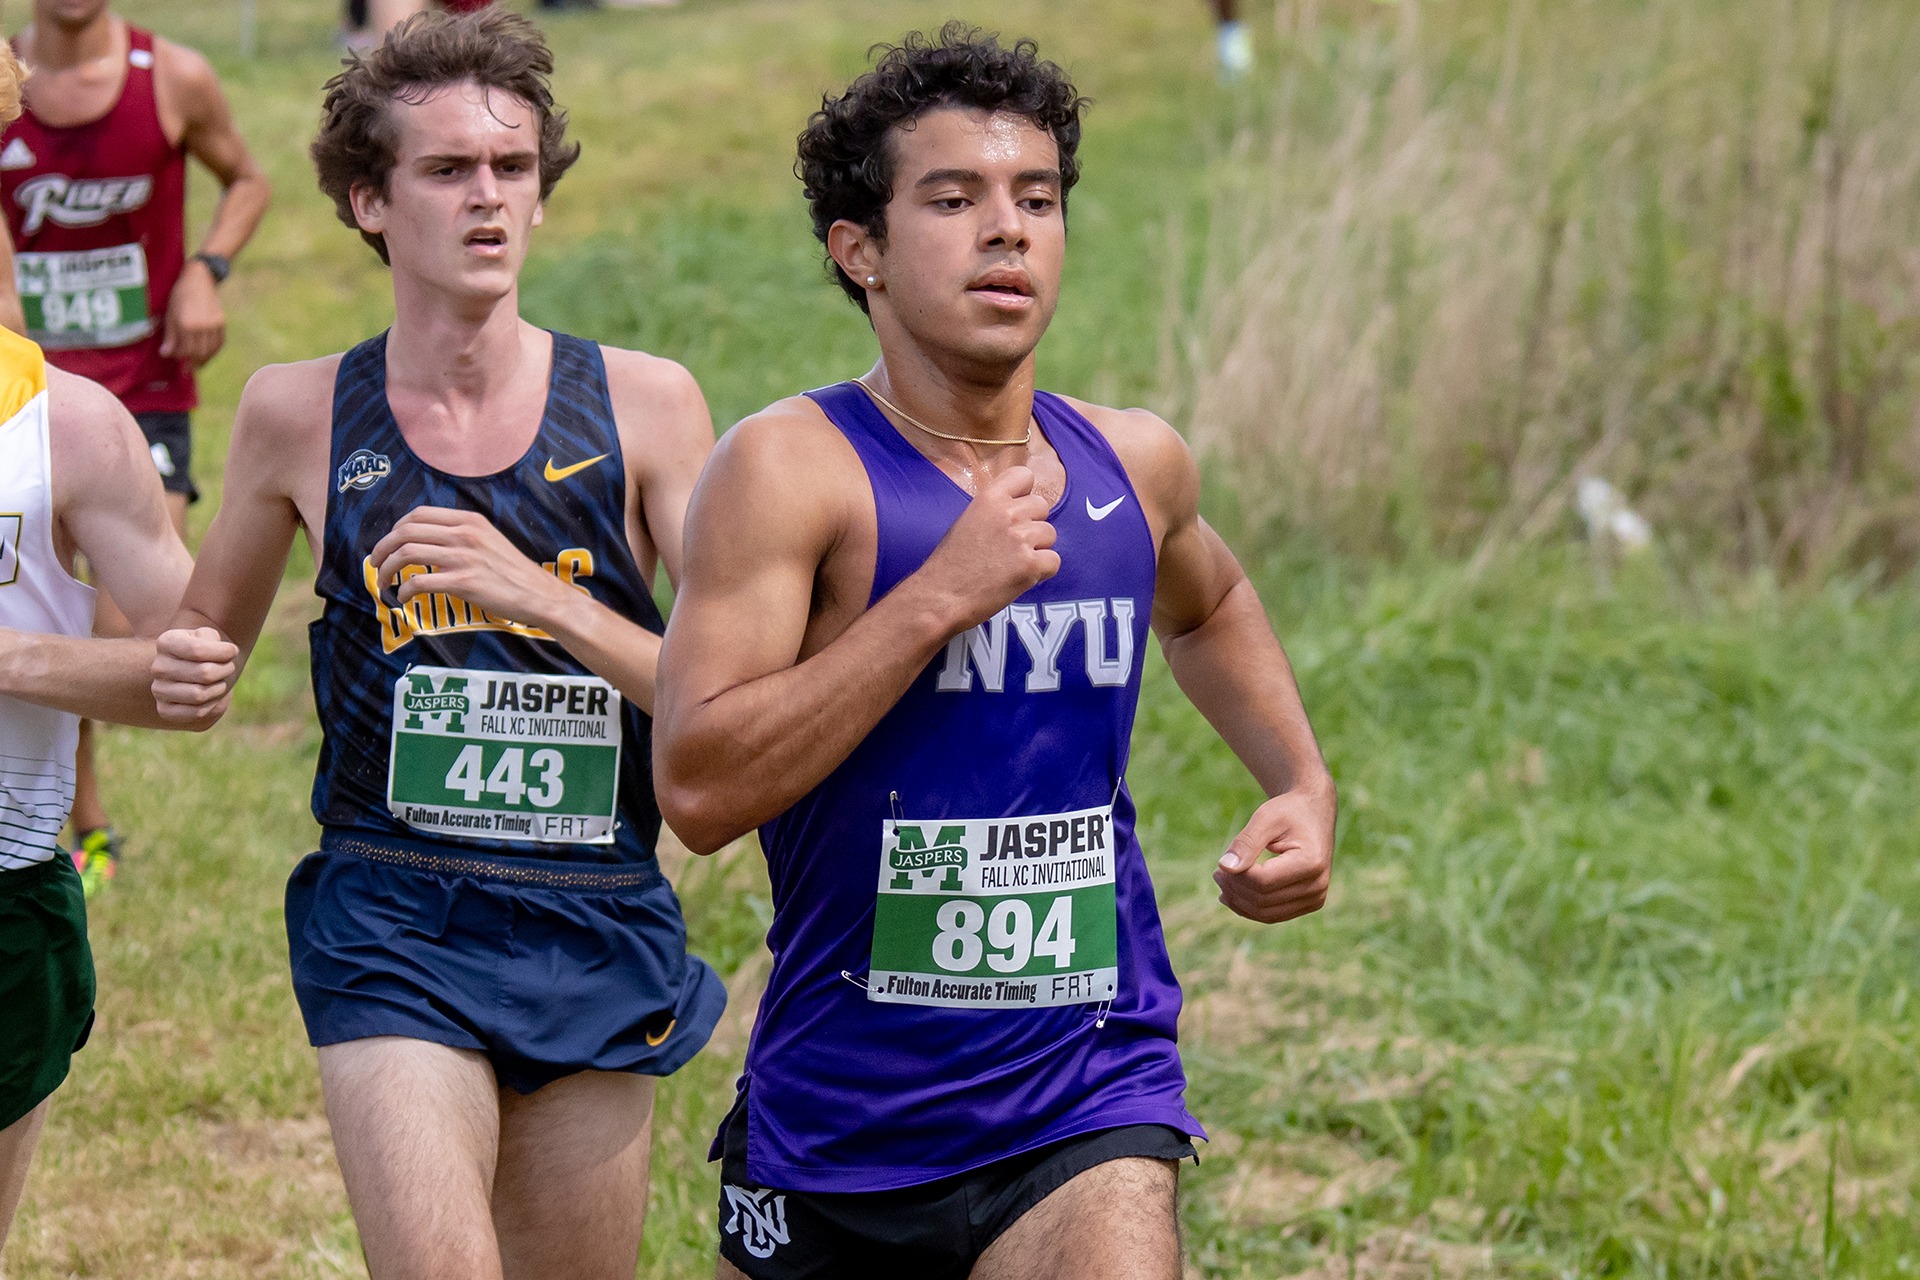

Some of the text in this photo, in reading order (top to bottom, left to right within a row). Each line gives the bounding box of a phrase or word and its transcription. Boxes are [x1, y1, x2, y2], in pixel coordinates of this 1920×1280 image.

[42, 288, 120, 333] 949
[339, 456, 387, 487] MAAC
[935, 597, 1136, 693] NYU
[407, 695, 465, 710] JASPERS
[480, 680, 609, 716] JASPER
[481, 715, 607, 739] FALL XC INVITATIONAL
[445, 744, 565, 808] 443
[405, 806, 531, 834] Fulton Accurate Timing
[979, 814, 1106, 861] JASPER
[894, 849, 964, 868] JASPERS
[981, 855, 1106, 888] FALL XC INVITATIONAL
[931, 895, 1076, 973] 894
[887, 975, 1037, 1003] Fulton Accurate Timing
